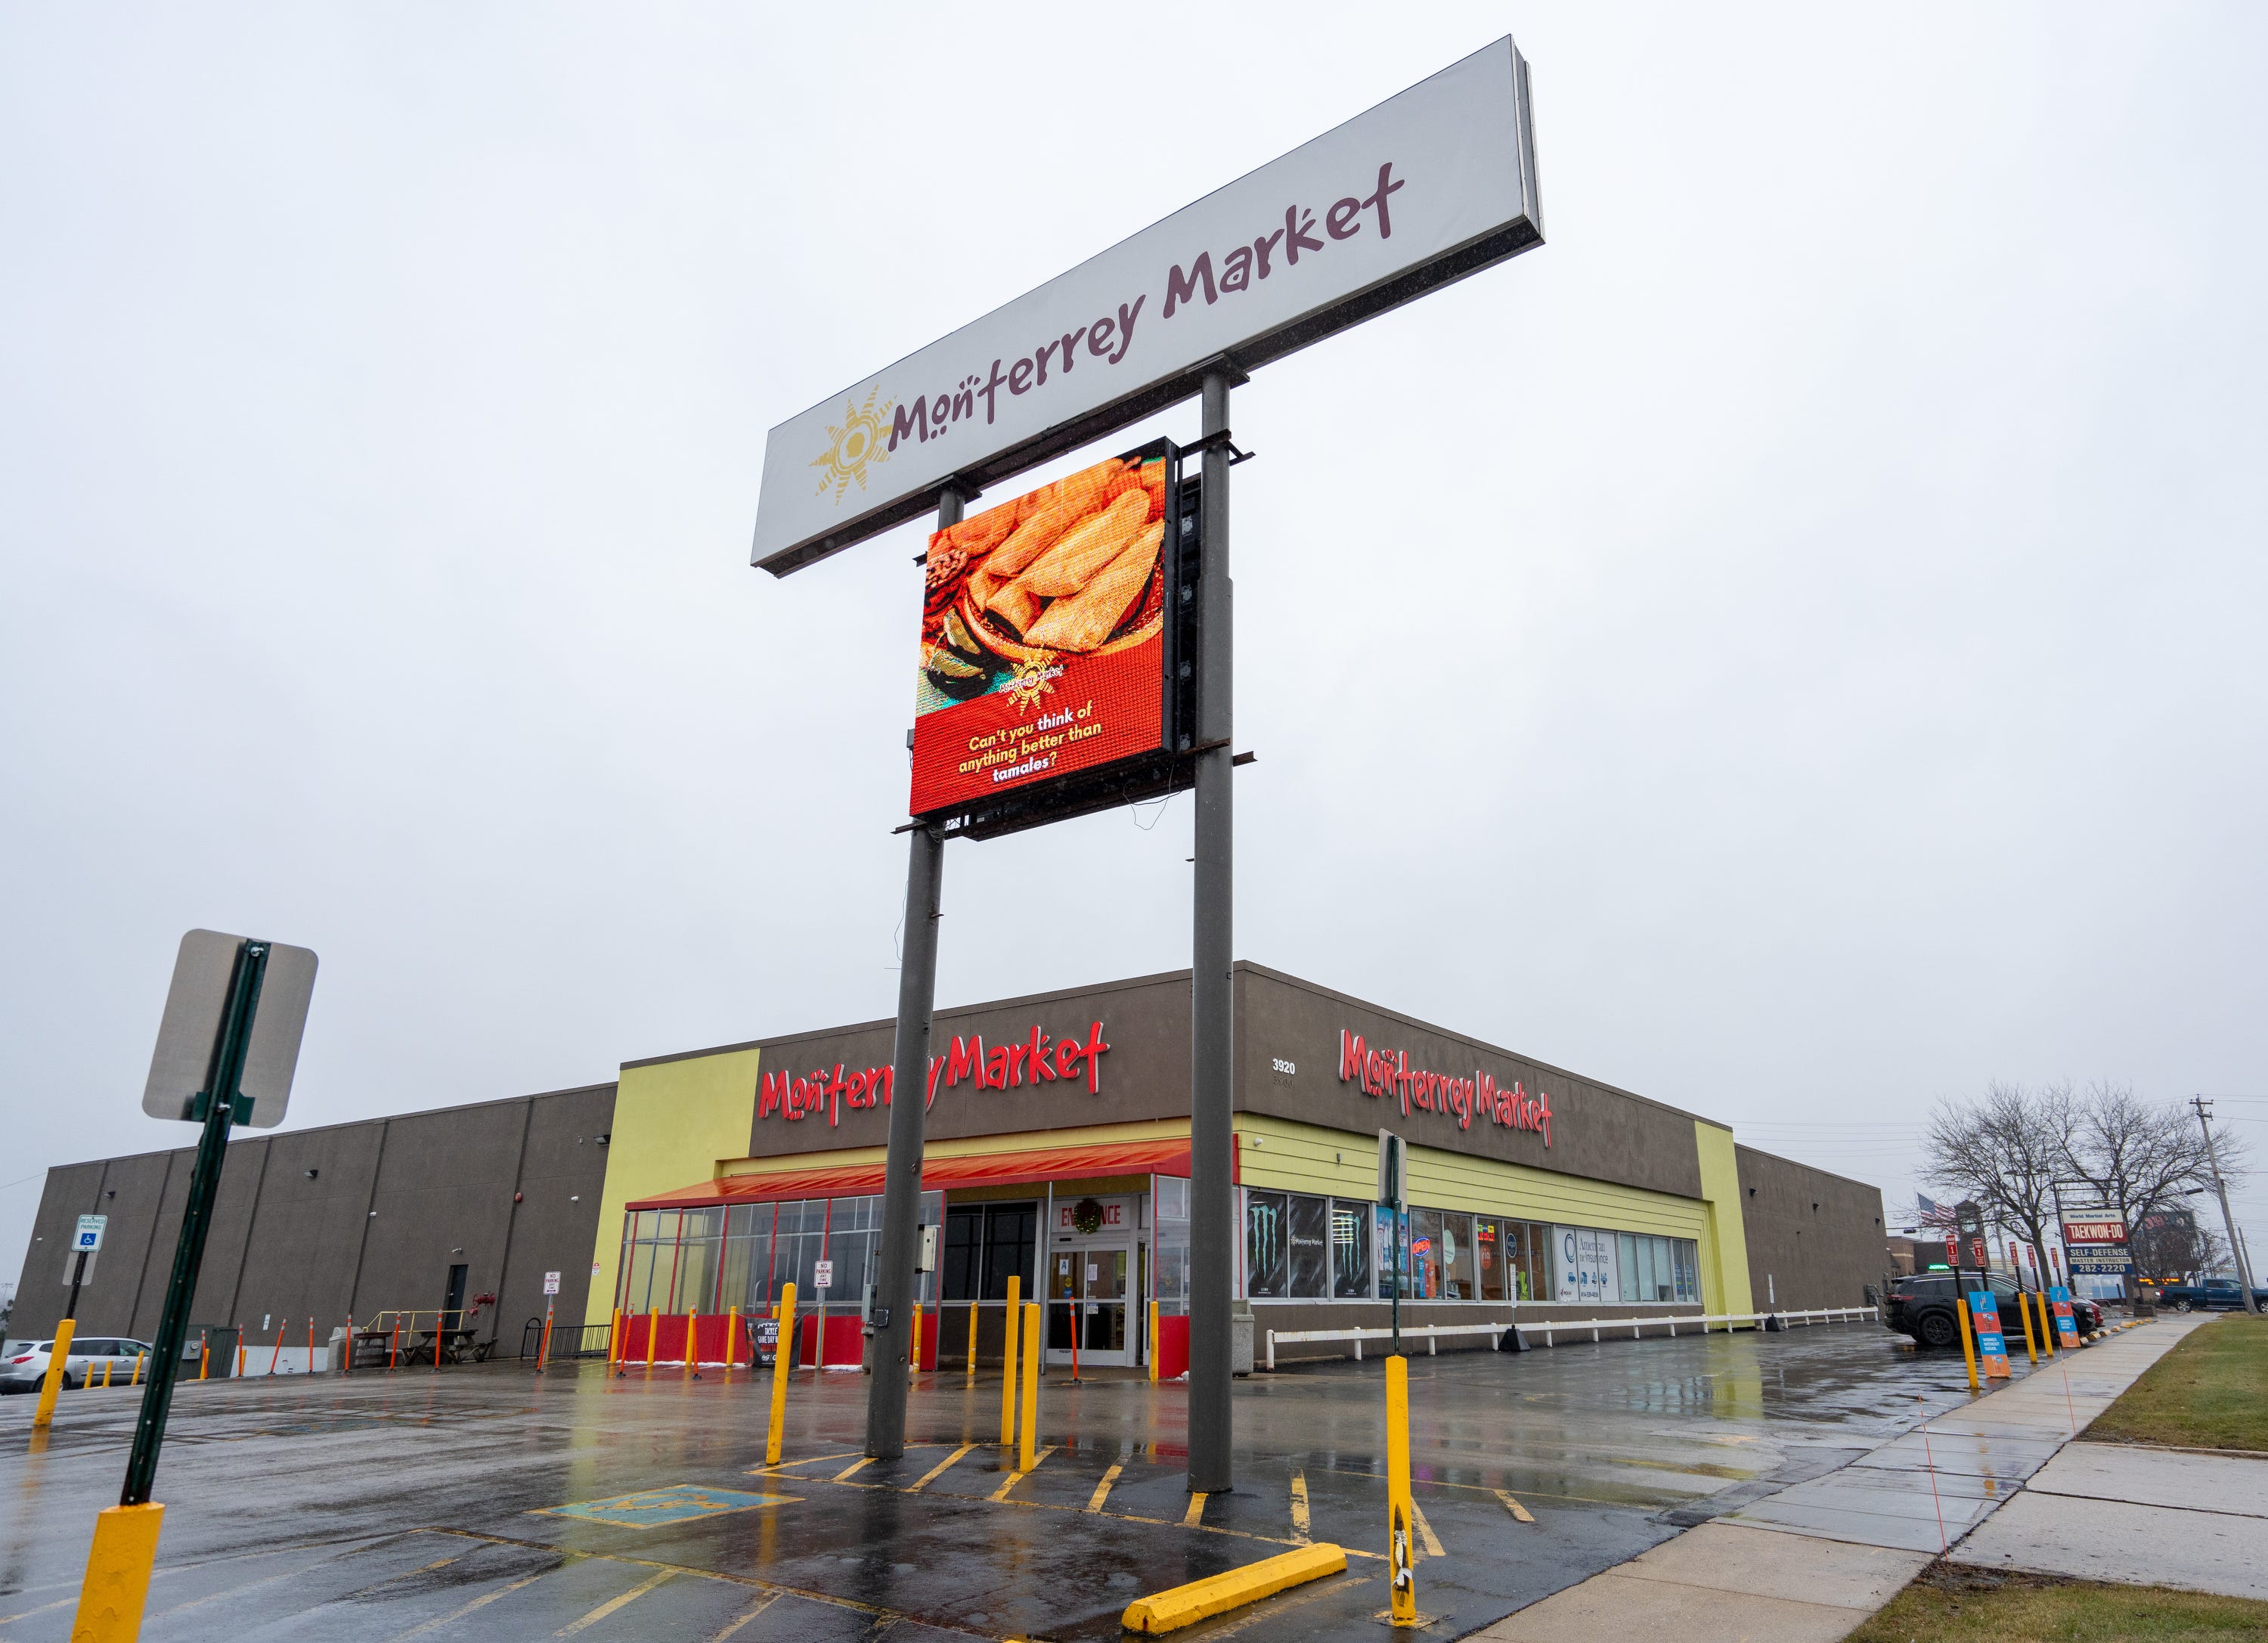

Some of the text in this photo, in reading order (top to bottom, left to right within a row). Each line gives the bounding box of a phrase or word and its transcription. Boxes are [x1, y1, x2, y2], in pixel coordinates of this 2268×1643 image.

[888, 162, 1405, 454] Monterrey Market
[968, 700, 1093, 751] Can't you think of
[958, 724, 1102, 773] anything better than
[992, 751, 1058, 783] tamales?
[758, 1021, 1111, 1127] Monterry Market
[1272, 1058, 1296, 1075] 3920
[1340, 1028, 1553, 1149] Monterrey Market
[1061, 1205, 1120, 1226] ENNCE
[2068, 1224, 2124, 1239] TAEKWON-DO
[1412, 1239, 1431, 1254] OPEN
[1579, 1236, 1606, 1251] Amerian
[1950, 1246, 1955, 1254] 1
[2070, 1248, 2129, 1257] SELF-DEFENSE
[1061, 1261, 1067, 1269] A
[2078, 1264, 2126, 1273] 282-2220
[758, 1335, 767, 1344] GAME
[767, 1335, 776, 1344] DAY
